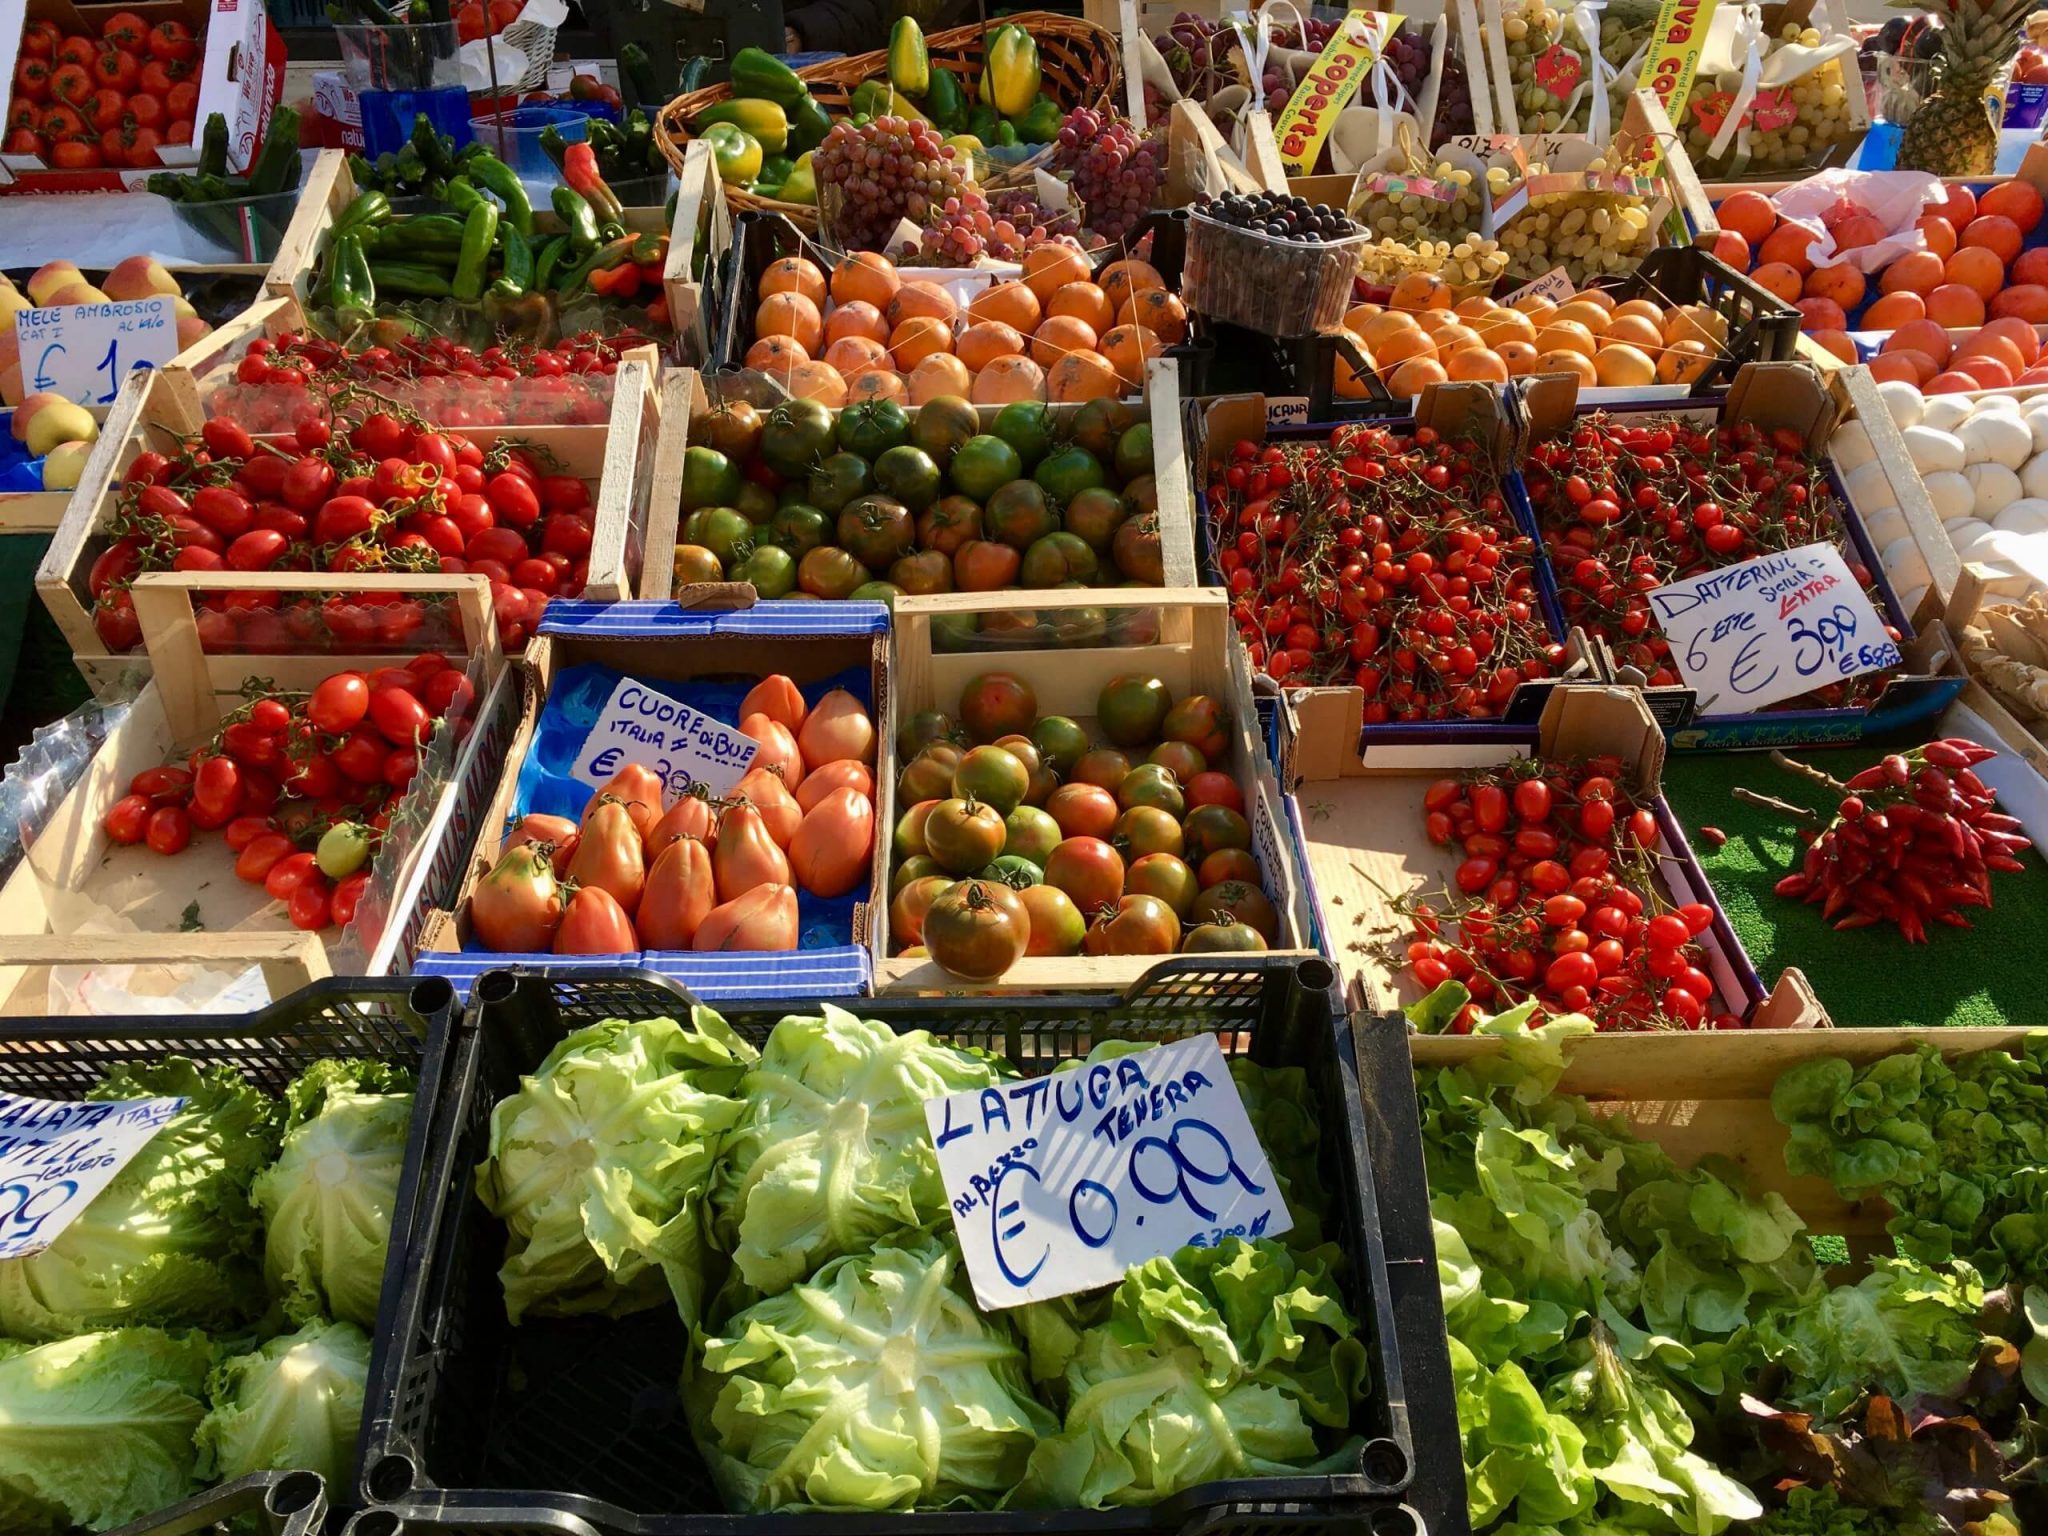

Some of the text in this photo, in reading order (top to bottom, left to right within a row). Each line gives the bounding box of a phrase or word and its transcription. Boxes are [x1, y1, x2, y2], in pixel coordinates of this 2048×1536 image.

[1645, 37, 1665, 75] Trauben
[1679, 50, 1698, 88] Covered
[1281, 53, 1356, 157] coperta
[75, 300, 162, 320] AMBROSIO
[21, 328, 45, 341] CAT
[1779, 574, 1841, 620] EXTRA
[610, 720, 665, 749] ITALIA
[117, 1098, 183, 1127] ITALIA
[1093, 1070, 1213, 1147] TENERA
[990, 1160, 1050, 1287] €
